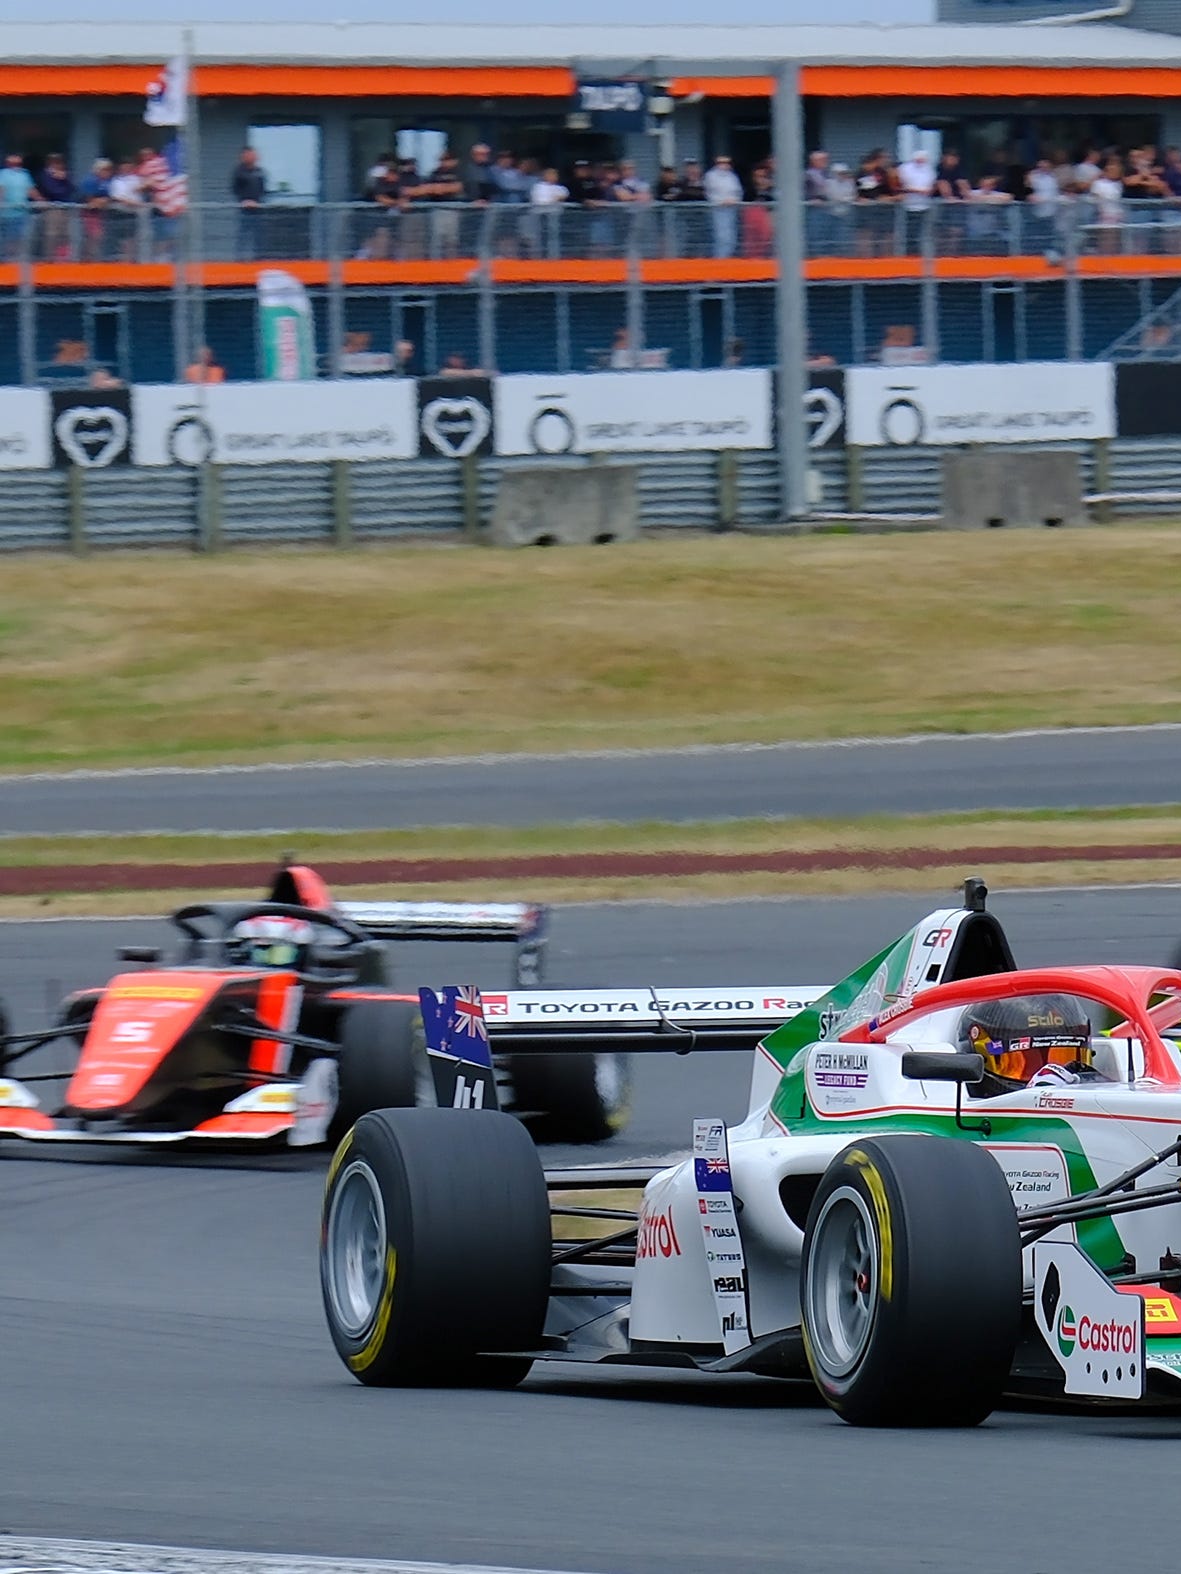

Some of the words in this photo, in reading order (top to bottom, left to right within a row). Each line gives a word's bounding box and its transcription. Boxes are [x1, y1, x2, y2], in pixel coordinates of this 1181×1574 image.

[516, 1002, 639, 1014] TOYOTA
[648, 1000, 755, 1012] GAZOO
[815, 1053, 833, 1069] PETER
[1015, 1181, 1052, 1192] Zealand
[711, 1228, 737, 1238] YUASA
[1078, 1315, 1137, 1354] Castrol
